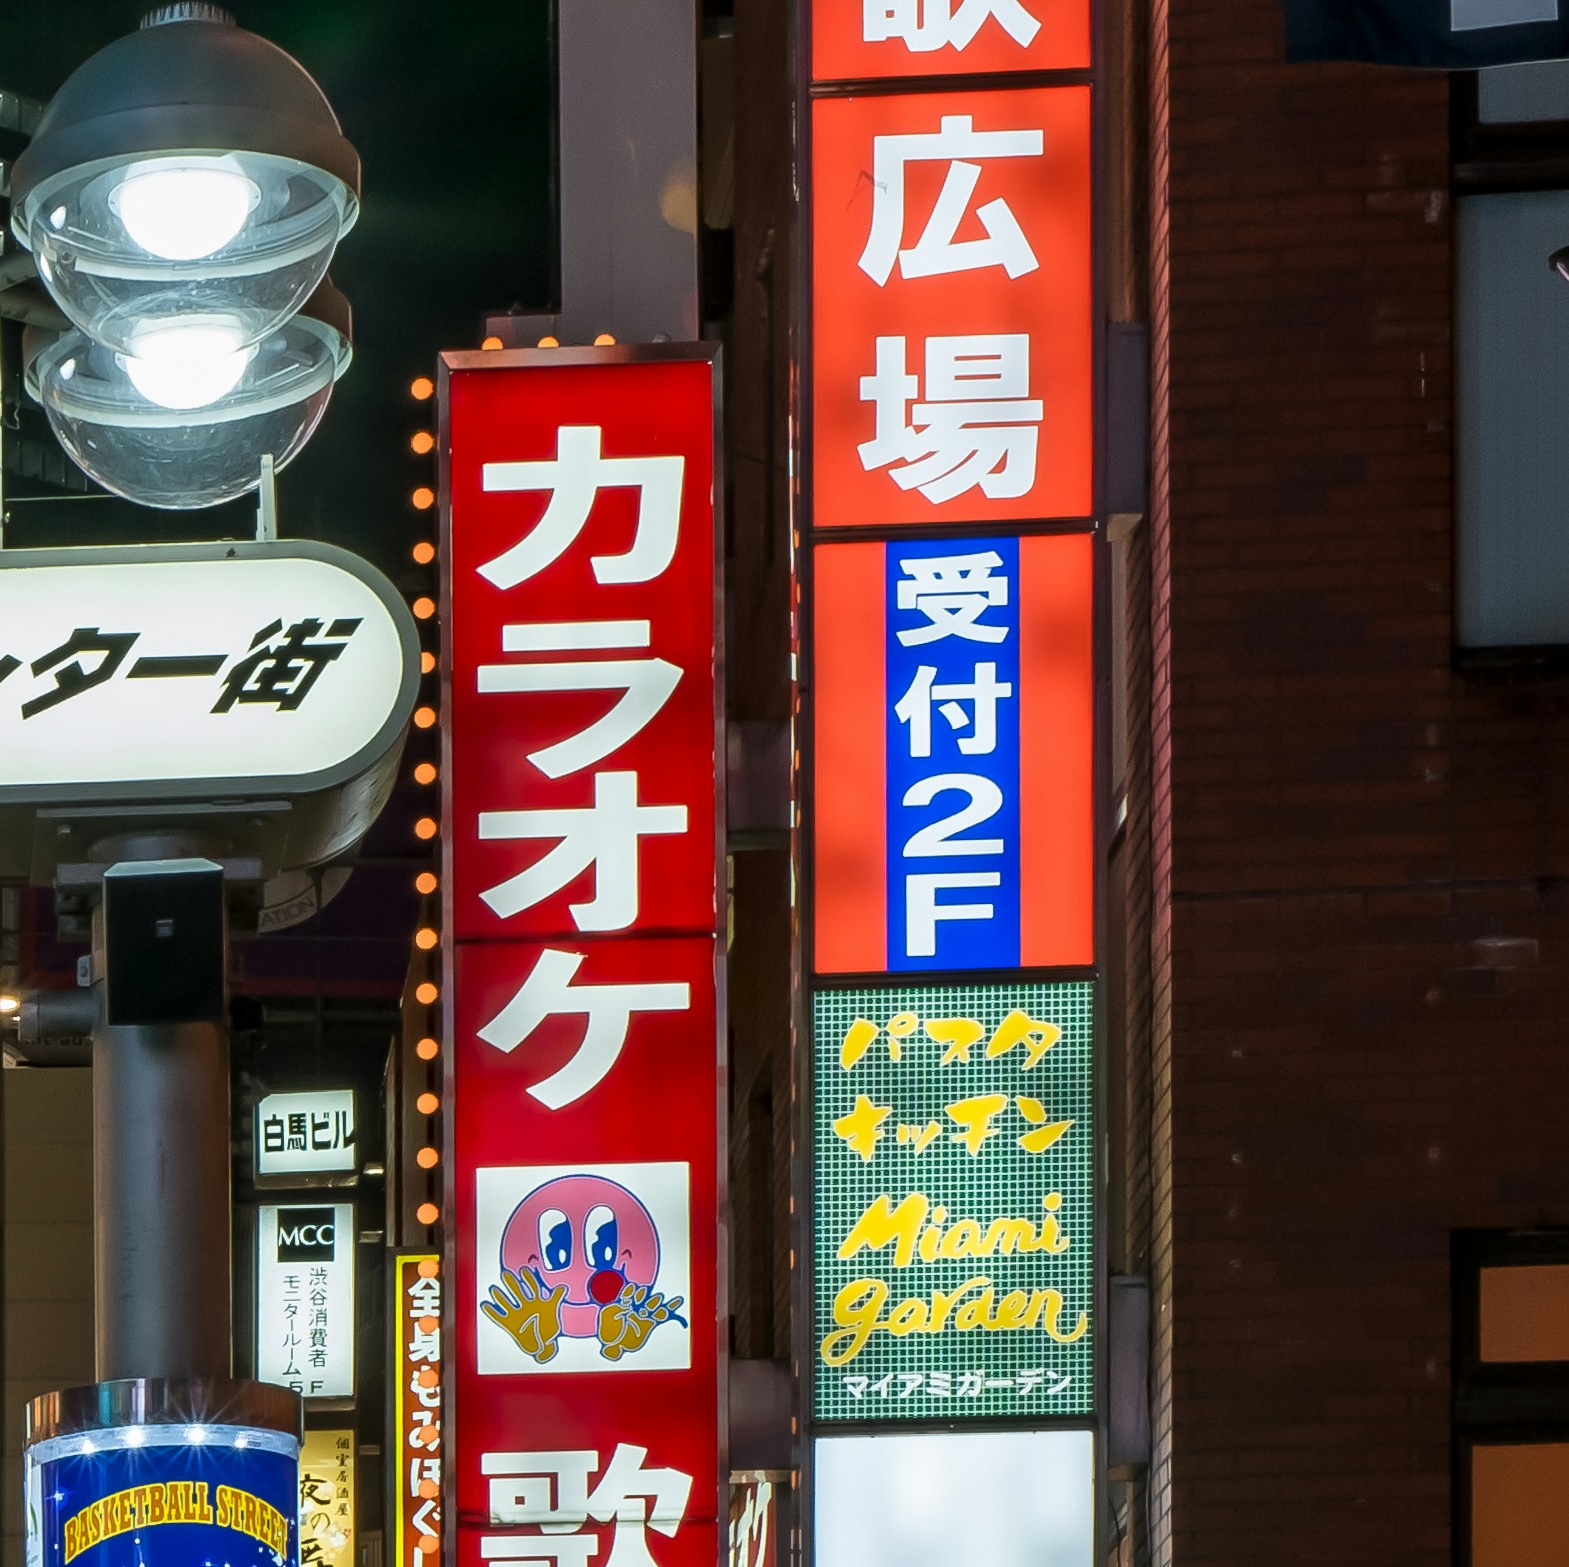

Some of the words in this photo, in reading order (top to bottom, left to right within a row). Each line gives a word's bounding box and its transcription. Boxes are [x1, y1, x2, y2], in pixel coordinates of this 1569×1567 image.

[476, 426, 690, 1111] カラオケ
[896, 551, 1012, 957] 受付2F
[839, 1009, 1063, 1072] パスタ
[263, 1111, 357, 1153] 白馬ビル
[833, 1093, 1076, 1164] キッチン
[278, 1225, 335, 1247] MCC
[837, 1190, 1070, 1269] Miami
[282, 1275, 301, 1376] モニタールーム
[309, 1267, 329, 1368] 渋谷消費者
[842, 1369, 1073, 1400] マイアミガーデン
[63, 1481, 213, 1563] BASKETBALL
[215, 1485, 288, 1562] STREET
